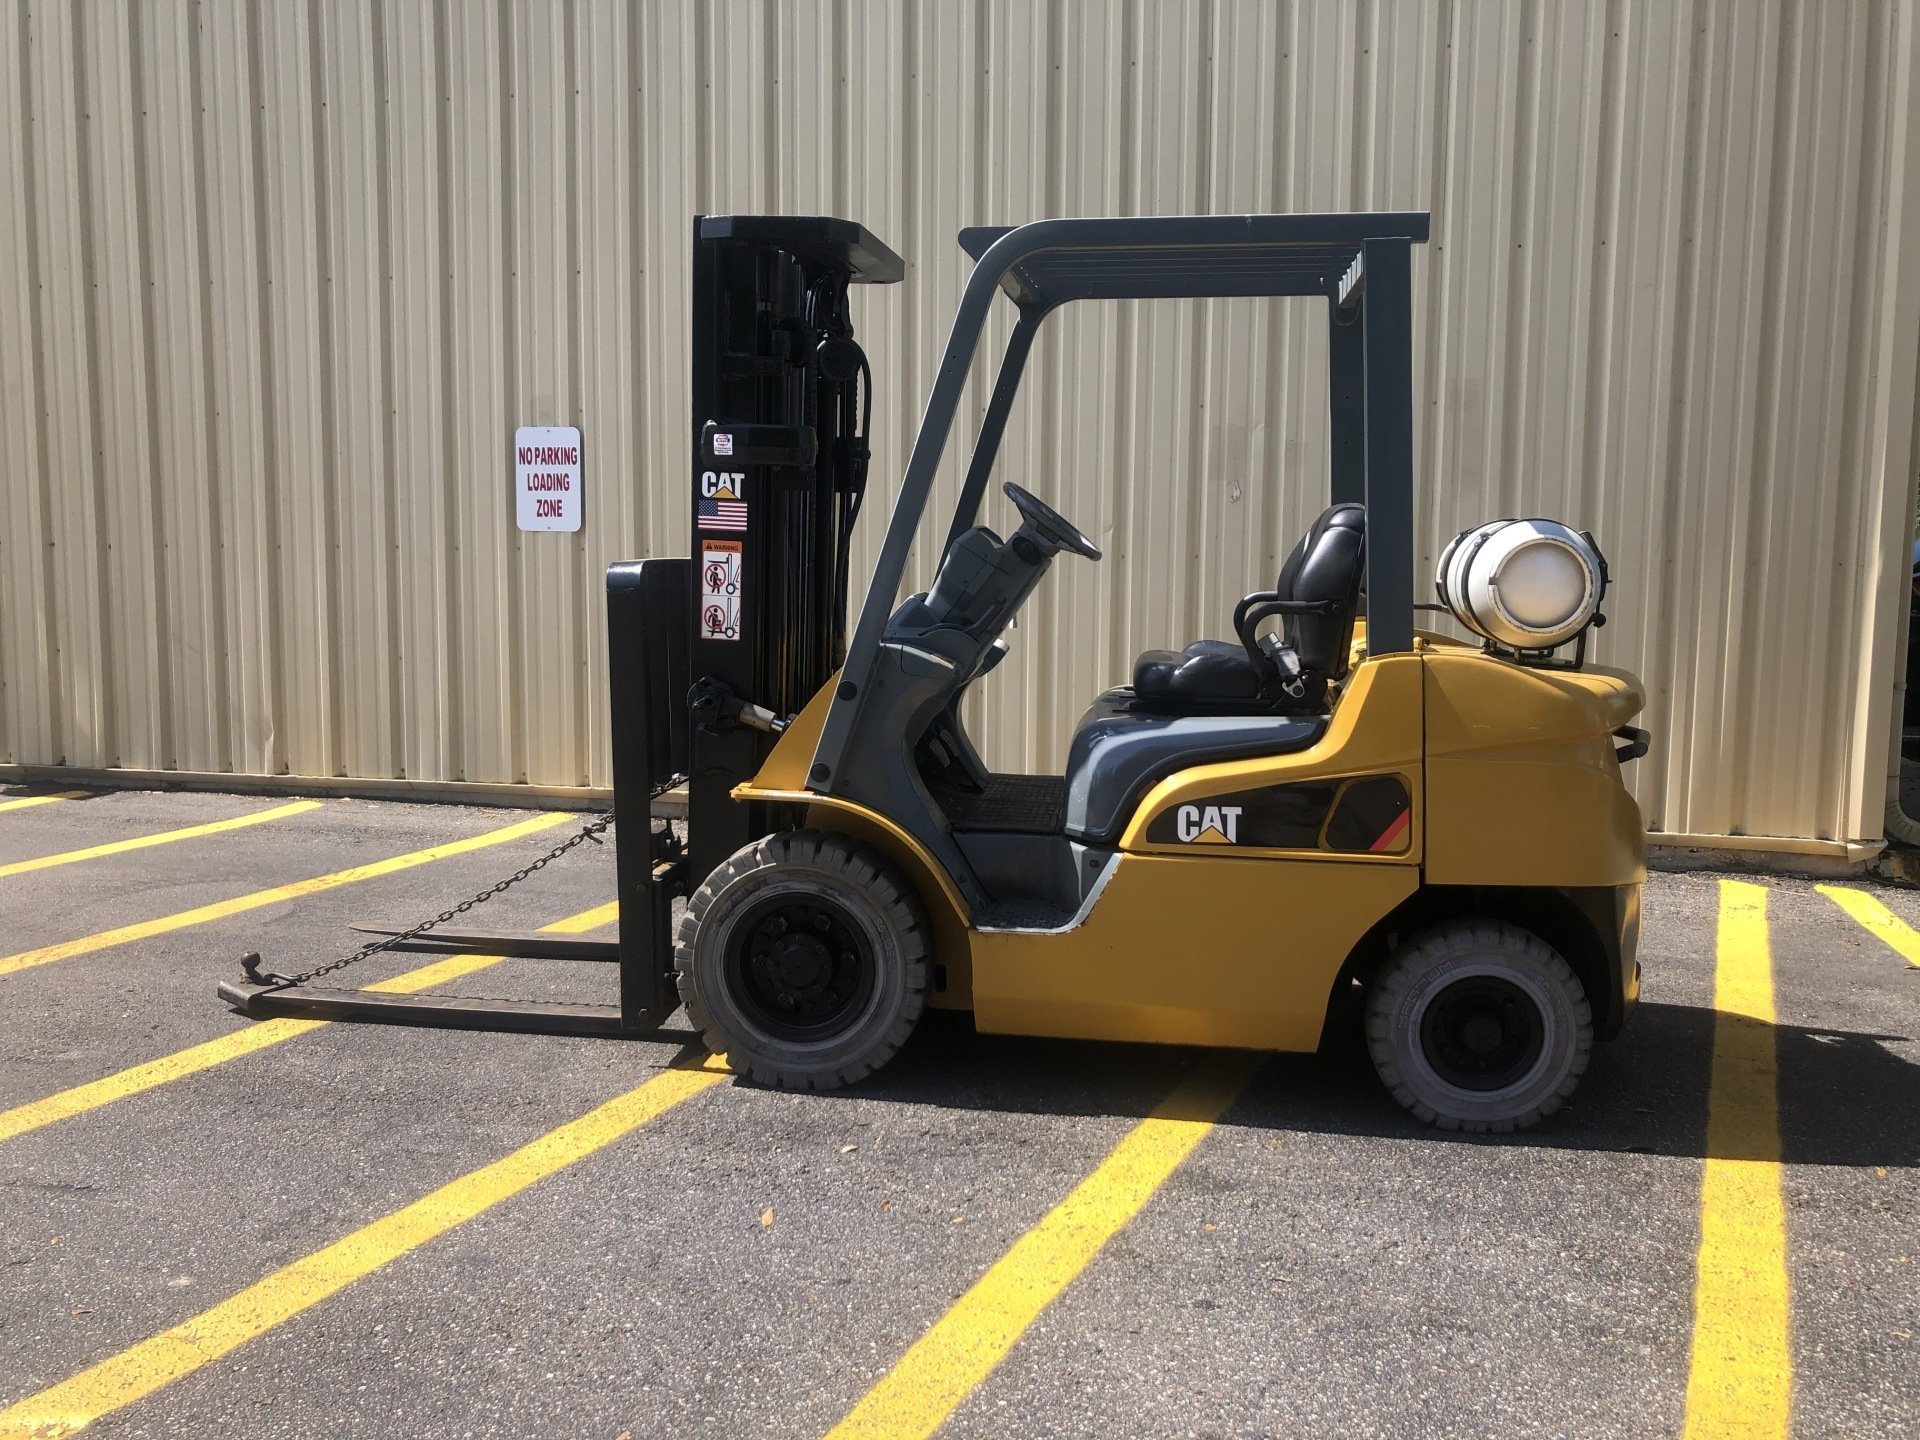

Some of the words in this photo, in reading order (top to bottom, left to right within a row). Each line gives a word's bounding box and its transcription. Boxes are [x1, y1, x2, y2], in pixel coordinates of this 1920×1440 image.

[519, 447, 533, 465] NO
[534, 447, 578, 465] PARKING
[527, 473, 570, 491] LOADING
[702, 471, 745, 499] CAT
[536, 499, 563, 518] ZONE
[713, 544, 739, 552] WARNING
[1177, 805, 1242, 844] CAT
